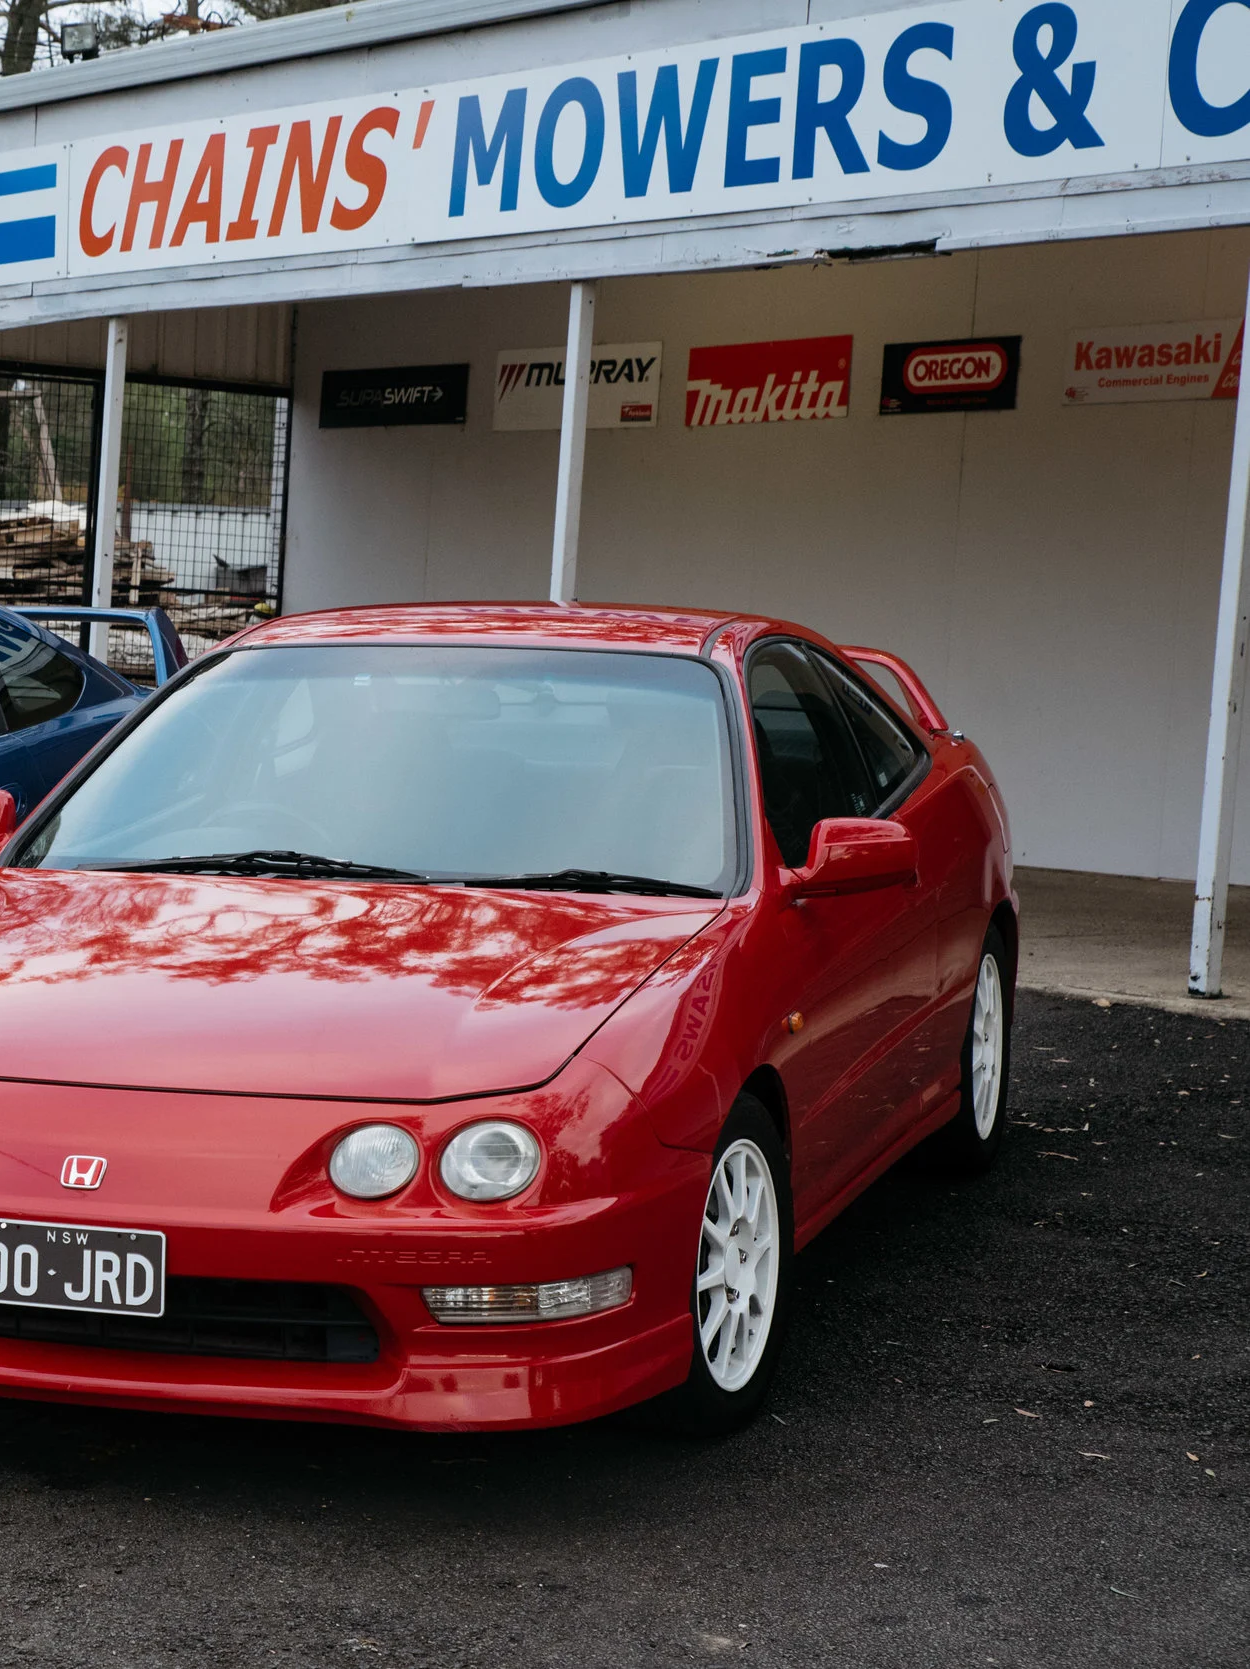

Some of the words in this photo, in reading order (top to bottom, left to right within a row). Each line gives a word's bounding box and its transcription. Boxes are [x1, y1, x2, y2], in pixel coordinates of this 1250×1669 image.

[79, 100, 435, 257] CHAINS'
[449, 22, 954, 217] MOWERS
[1003, 3, 1105, 157] &
[1075, 333, 1222, 371] Kawasaki
[913, 356, 991, 382] OREGON
[1098, 375, 1163, 388] Commercial
[1166, 373, 1209, 387] Engines
[46, 1230, 89, 1246] NSW
